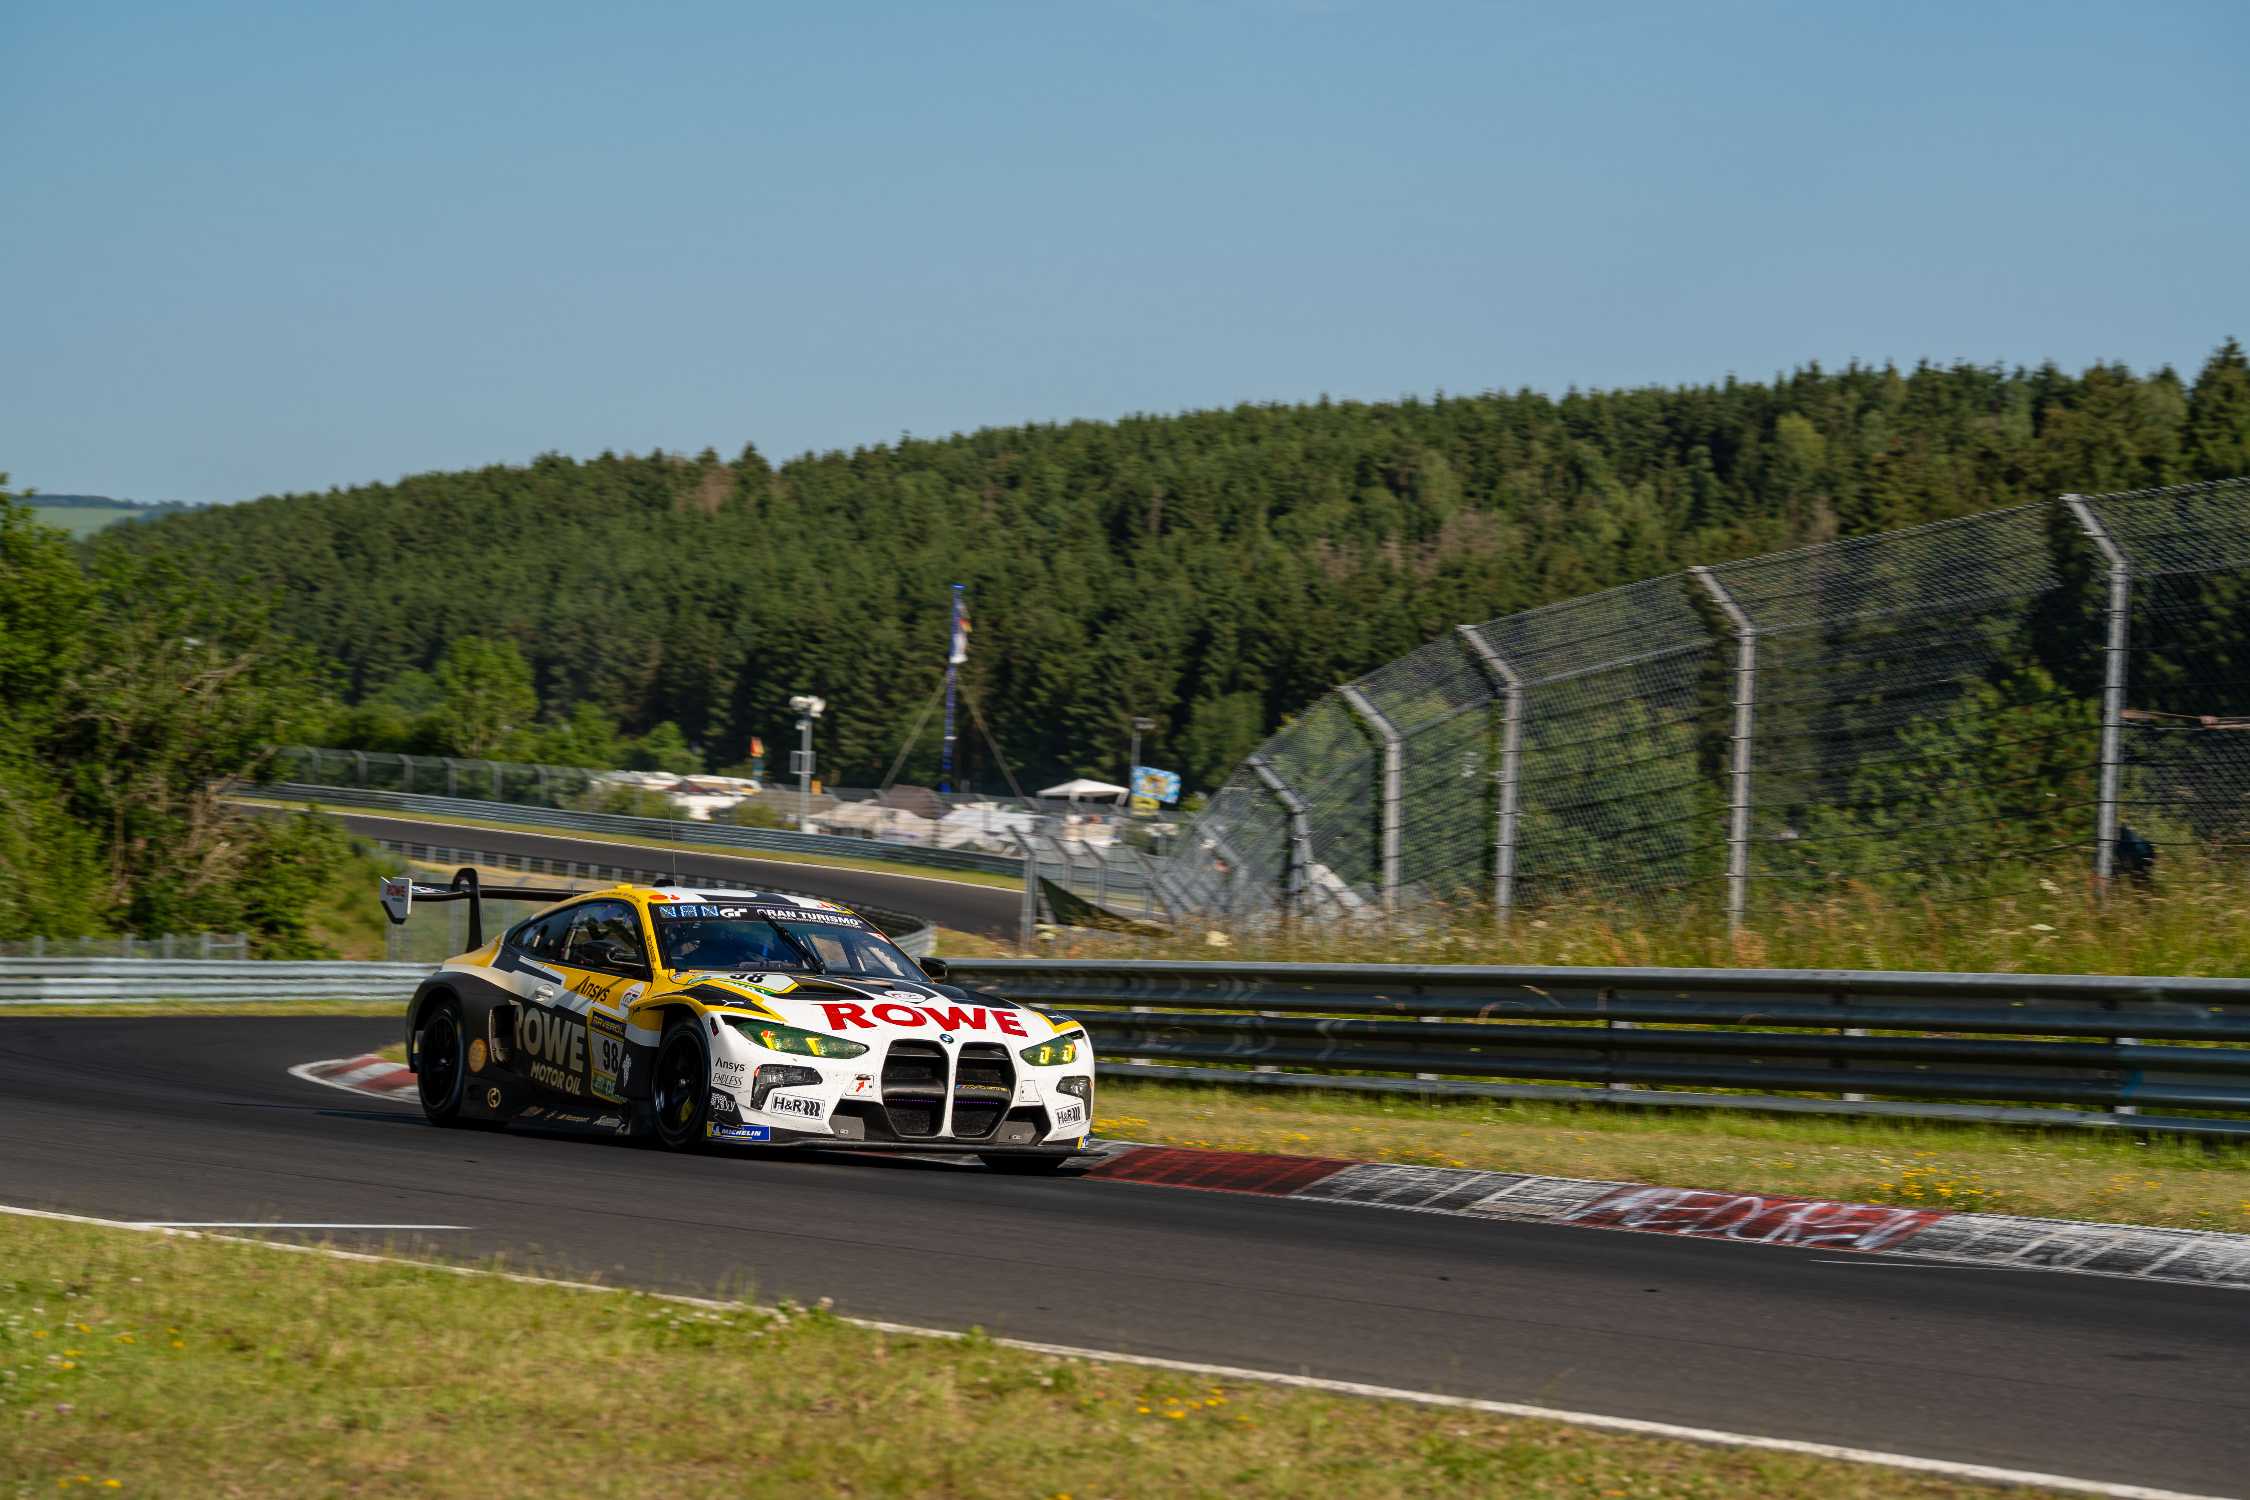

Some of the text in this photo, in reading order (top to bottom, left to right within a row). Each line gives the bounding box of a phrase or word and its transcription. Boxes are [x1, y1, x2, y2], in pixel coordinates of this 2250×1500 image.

[798, 911, 859, 926] TURISMO
[574, 976, 610, 1003] Ansys
[820, 1003, 1029, 1037] ROWE
[602, 1039, 620, 1072] 98
[715, 1057, 745, 1072] Ansys
[530, 1061, 564, 1089] MOTOR
[566, 1075, 583, 1096] OIL
[773, 1096, 802, 1113] H&R
[721, 1128, 762, 1137] MICHELIN
